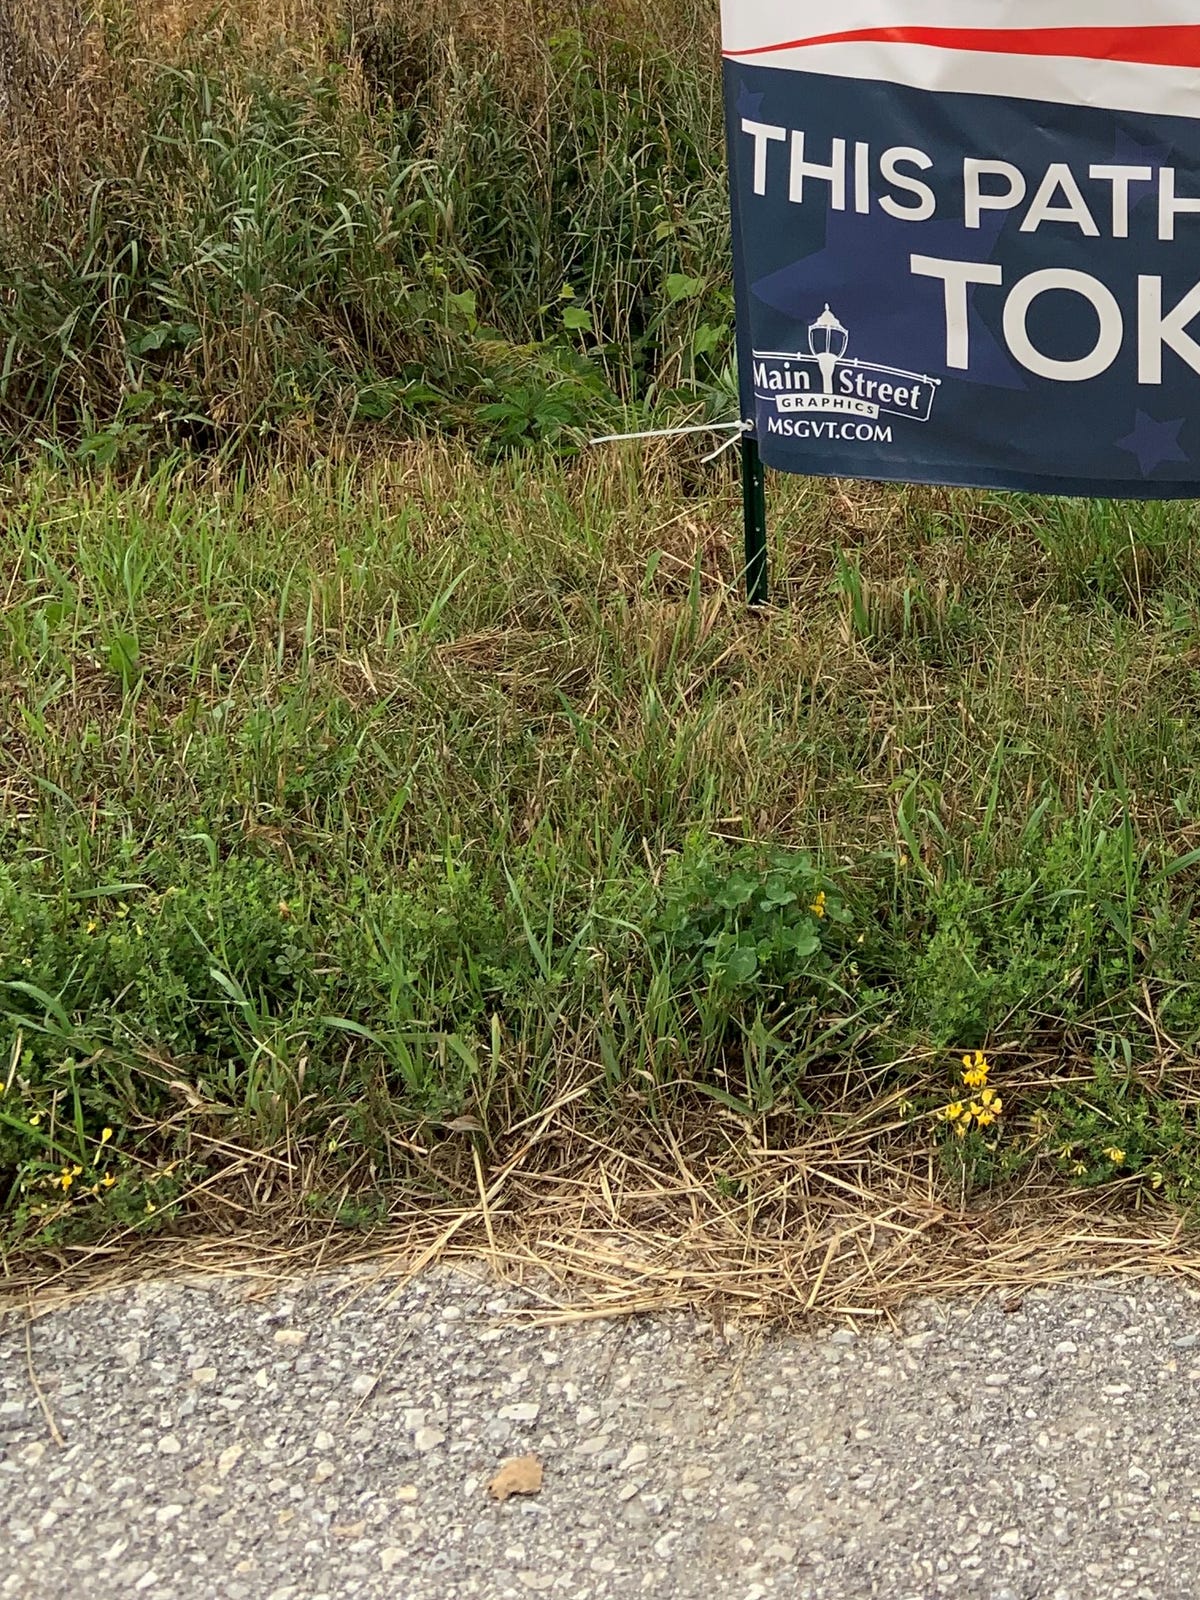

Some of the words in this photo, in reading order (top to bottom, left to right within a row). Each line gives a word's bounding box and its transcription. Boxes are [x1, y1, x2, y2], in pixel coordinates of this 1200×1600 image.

[741, 117, 937, 221] THIS
[752, 360, 810, 390] Main
[839, 369, 921, 410] Street
[781, 397, 874, 414] GRAPHICS
[768, 416, 893, 442] MSGVT.COM
